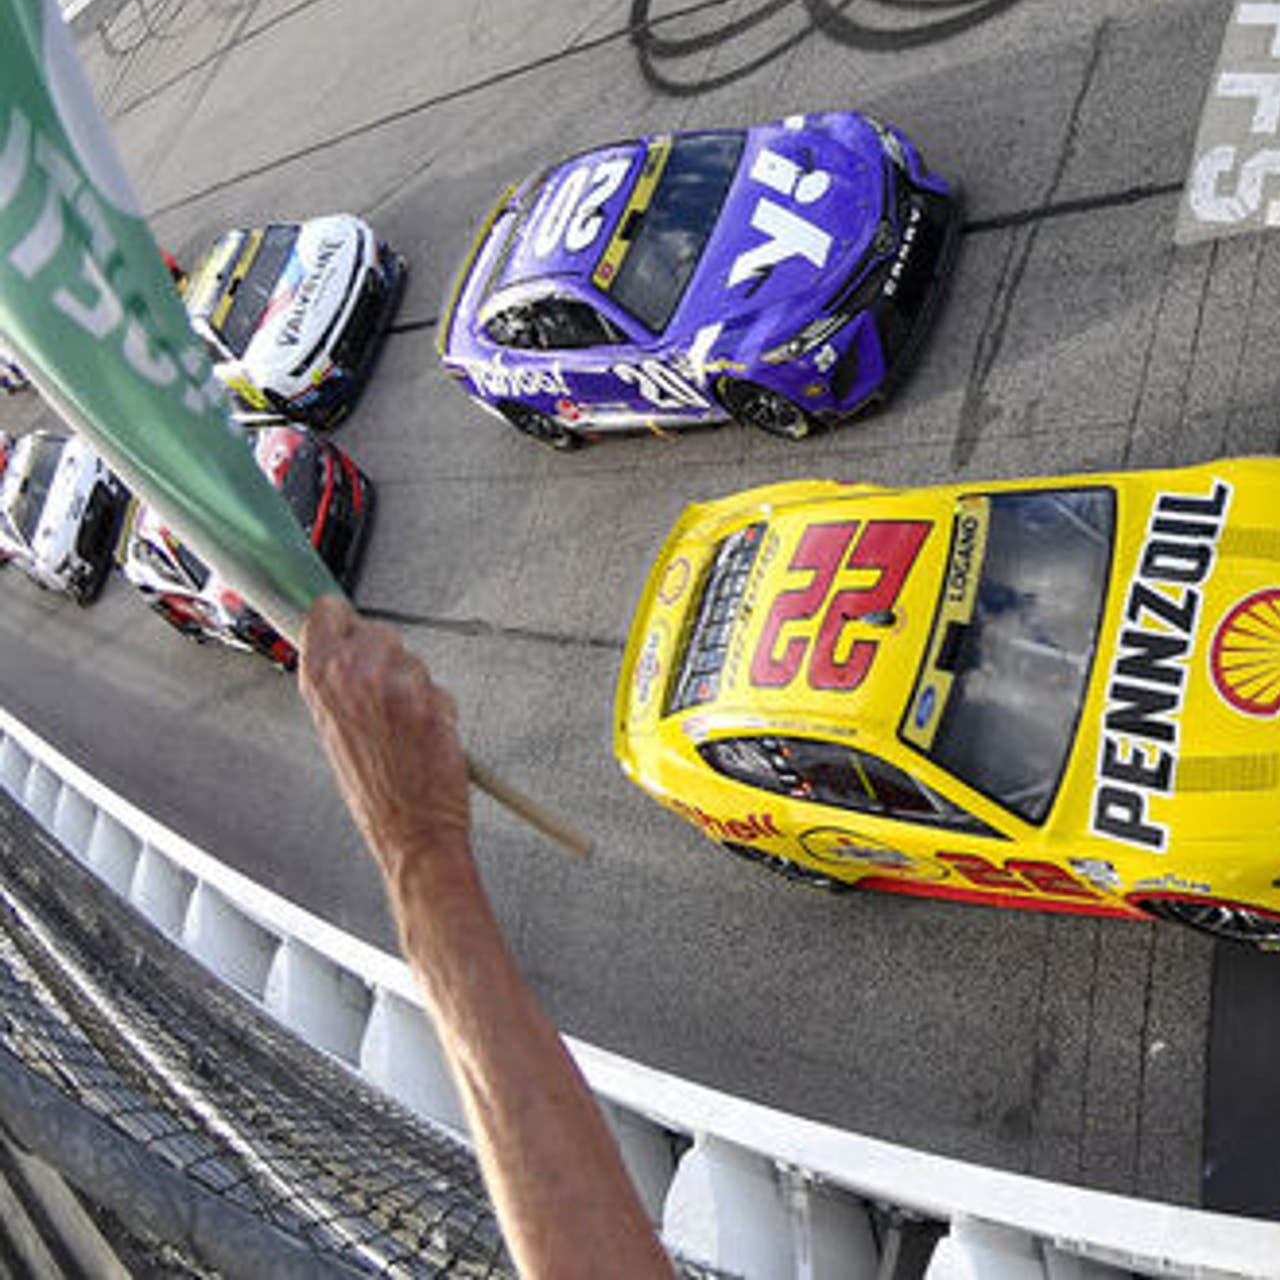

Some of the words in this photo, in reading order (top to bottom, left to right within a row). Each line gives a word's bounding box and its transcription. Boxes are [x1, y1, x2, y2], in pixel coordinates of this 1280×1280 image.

[533, 157, 633, 258] 20
[613, 360, 714, 410] 20
[750, 519, 936, 690] 22
[950, 516, 979, 603] LOGANO
[1092, 478, 1235, 851] PENNZOIL
[935, 851, 1107, 900] 22
